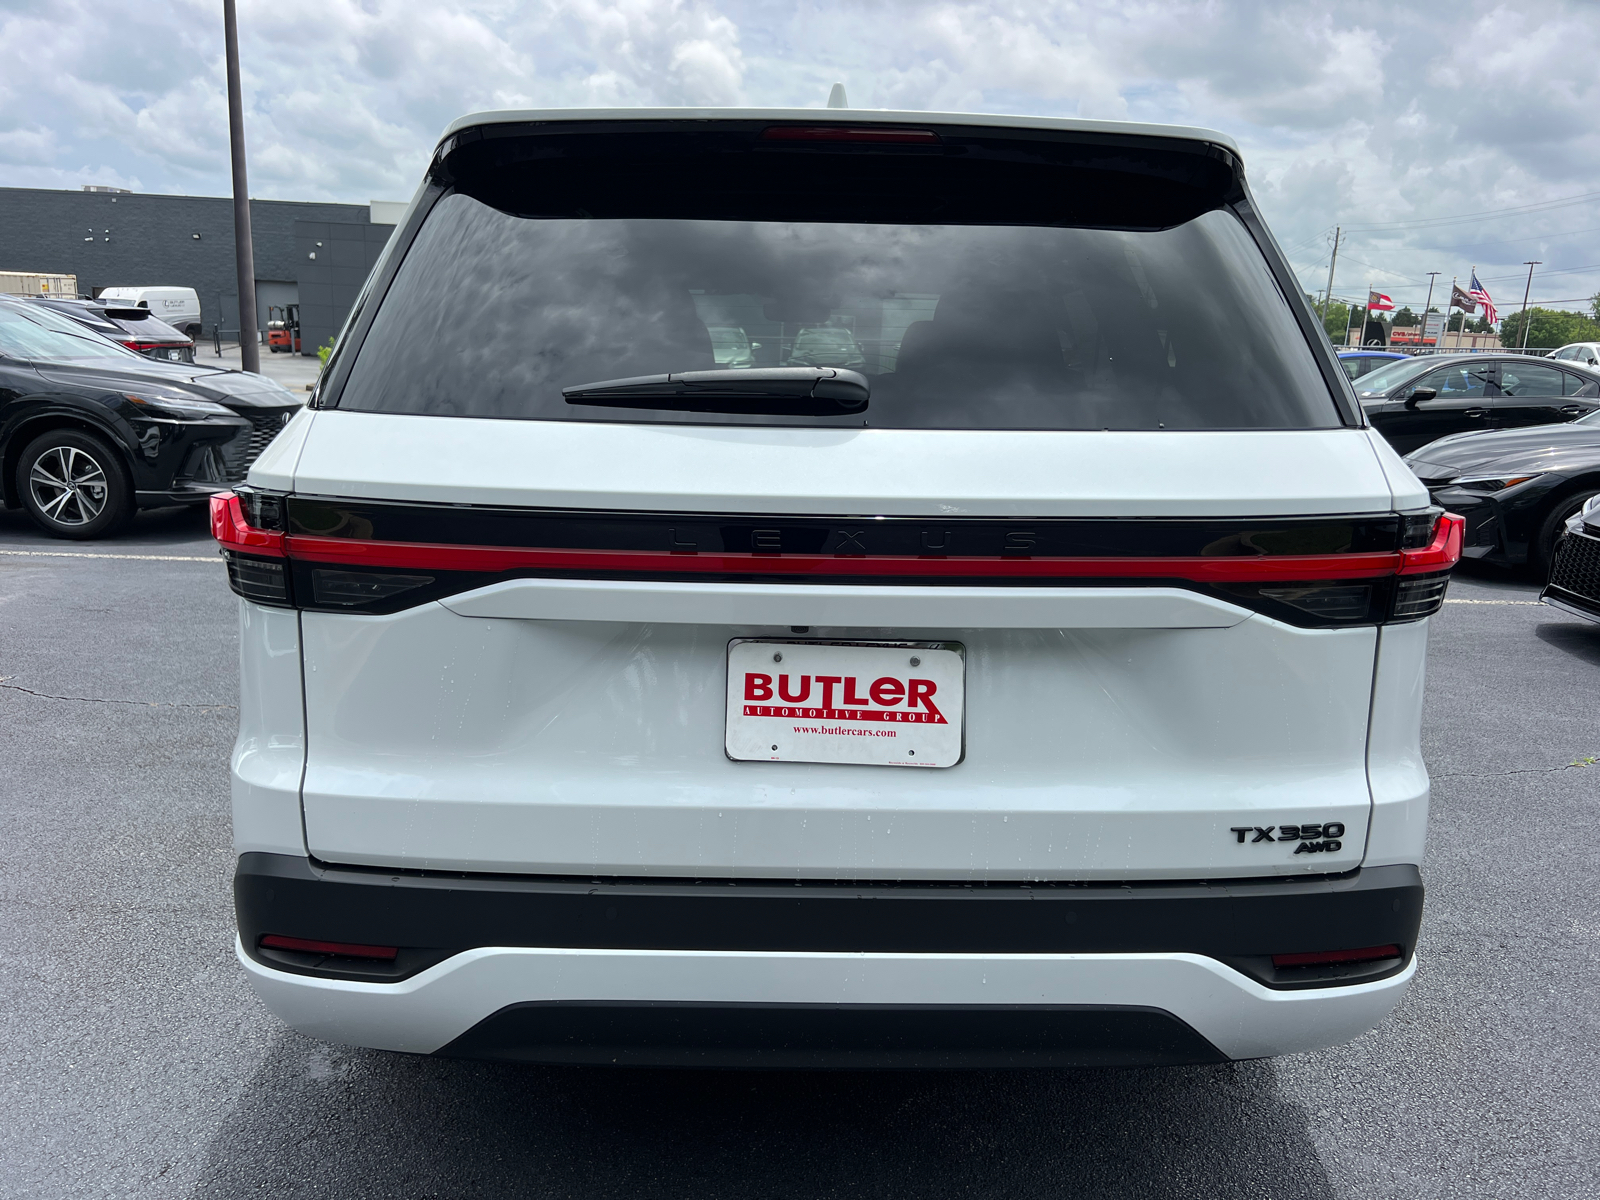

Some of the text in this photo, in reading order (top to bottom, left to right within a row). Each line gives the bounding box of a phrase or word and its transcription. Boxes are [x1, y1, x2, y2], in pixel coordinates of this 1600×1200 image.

[668, 527, 1037, 551] LEXUS
[744, 706, 941, 723] AUTOMOTIVE GROUP
[793, 725, 897, 738] www.butlercars.com
[1293, 839, 1342, 854] AWD
